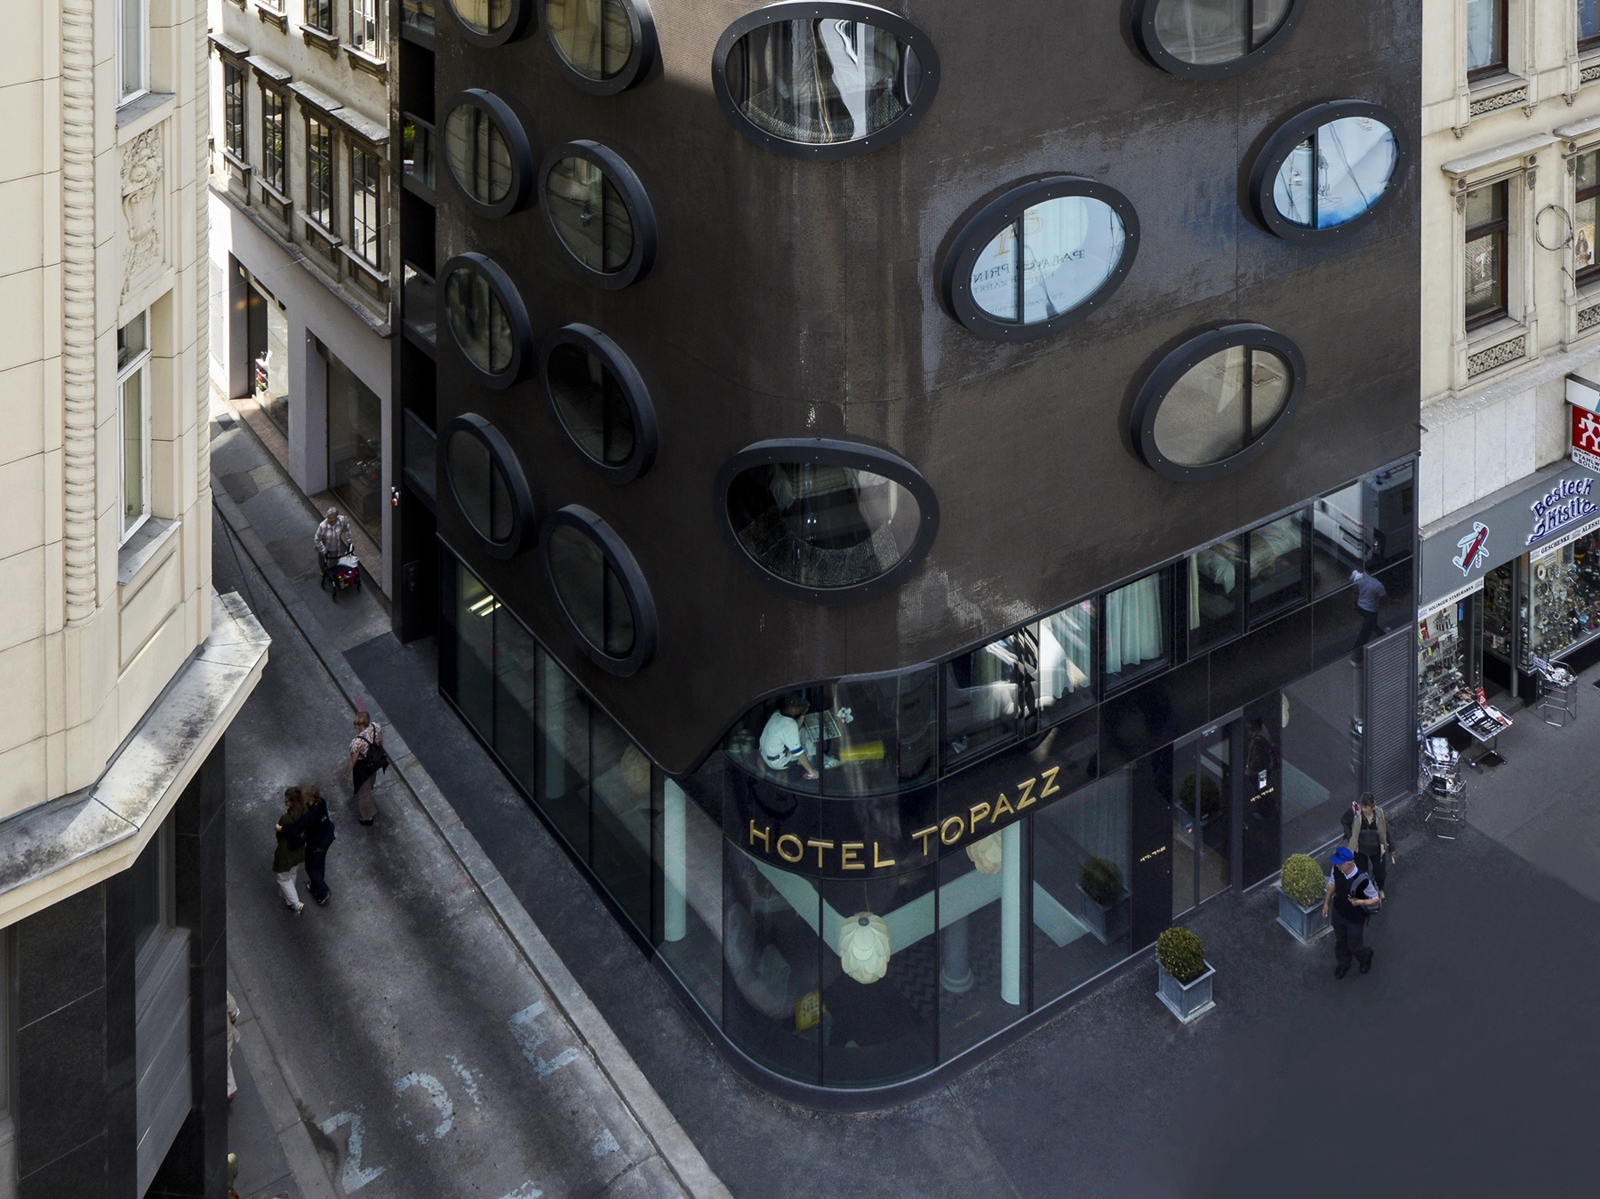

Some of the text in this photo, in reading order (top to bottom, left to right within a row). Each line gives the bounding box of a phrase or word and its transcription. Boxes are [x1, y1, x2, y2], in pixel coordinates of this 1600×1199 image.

[1578, 458, 1600, 472] SOLIN
[1531, 477, 1594, 520] Besteck
[1541, 534, 1571, 554] GESCHENKE
[750, 765, 1061, 870] HOTEL TOPAZZ
